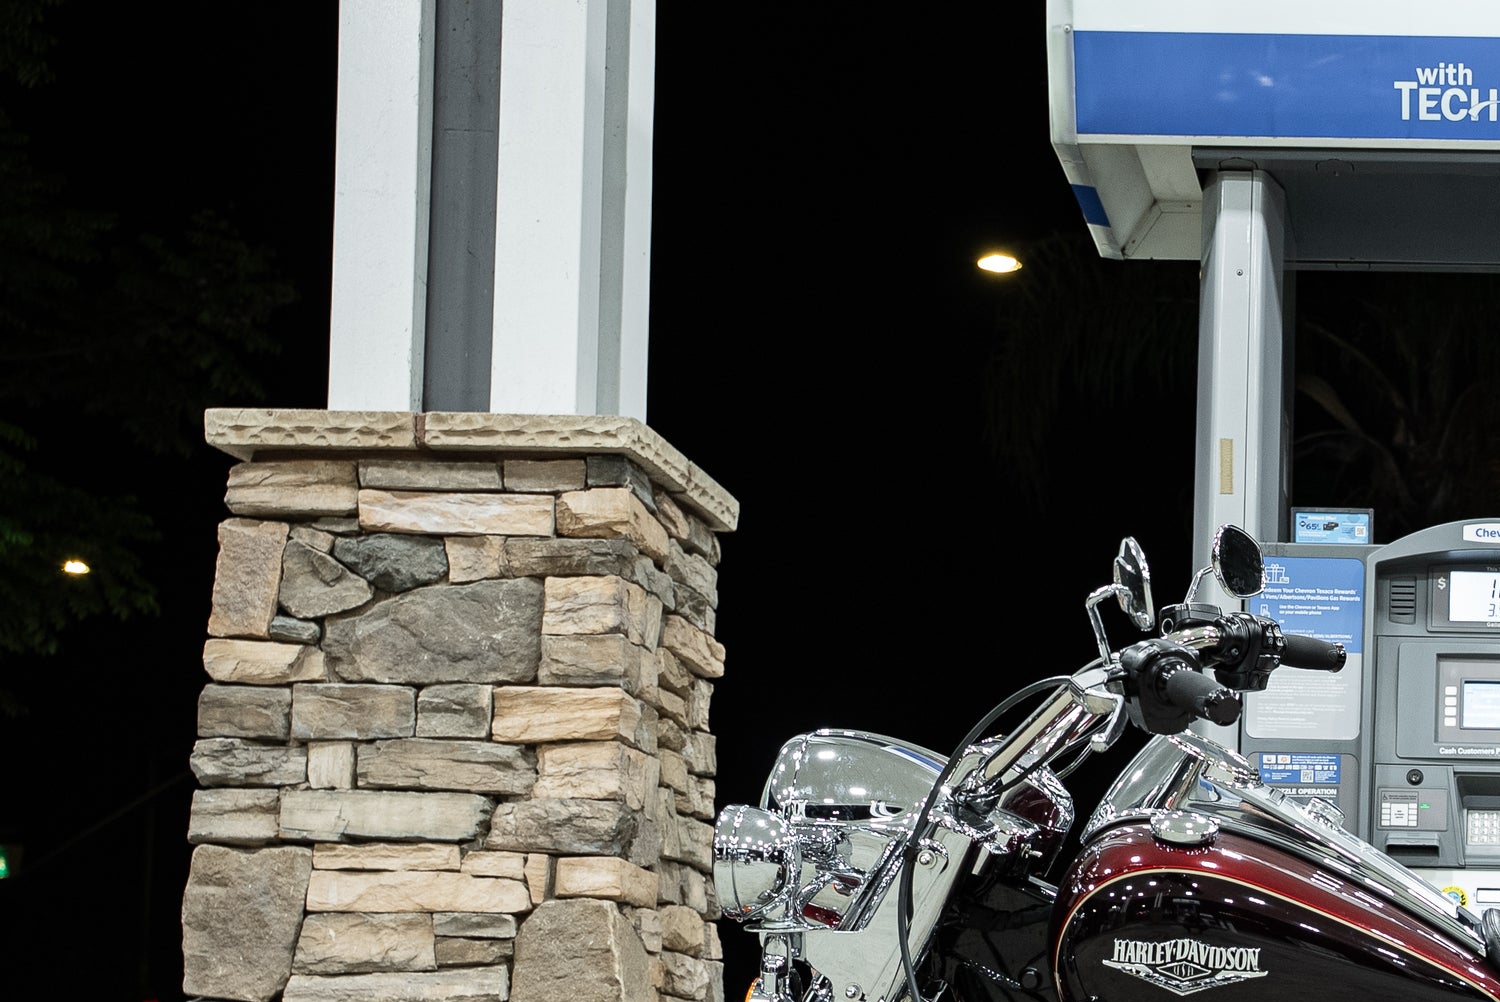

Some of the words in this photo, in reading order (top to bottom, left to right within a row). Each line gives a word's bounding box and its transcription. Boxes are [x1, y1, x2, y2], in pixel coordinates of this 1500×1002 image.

[1416, 62, 1472, 86] with
[1438, 576, 1446, 590] $
[1173, 963, 1194, 976] USA
